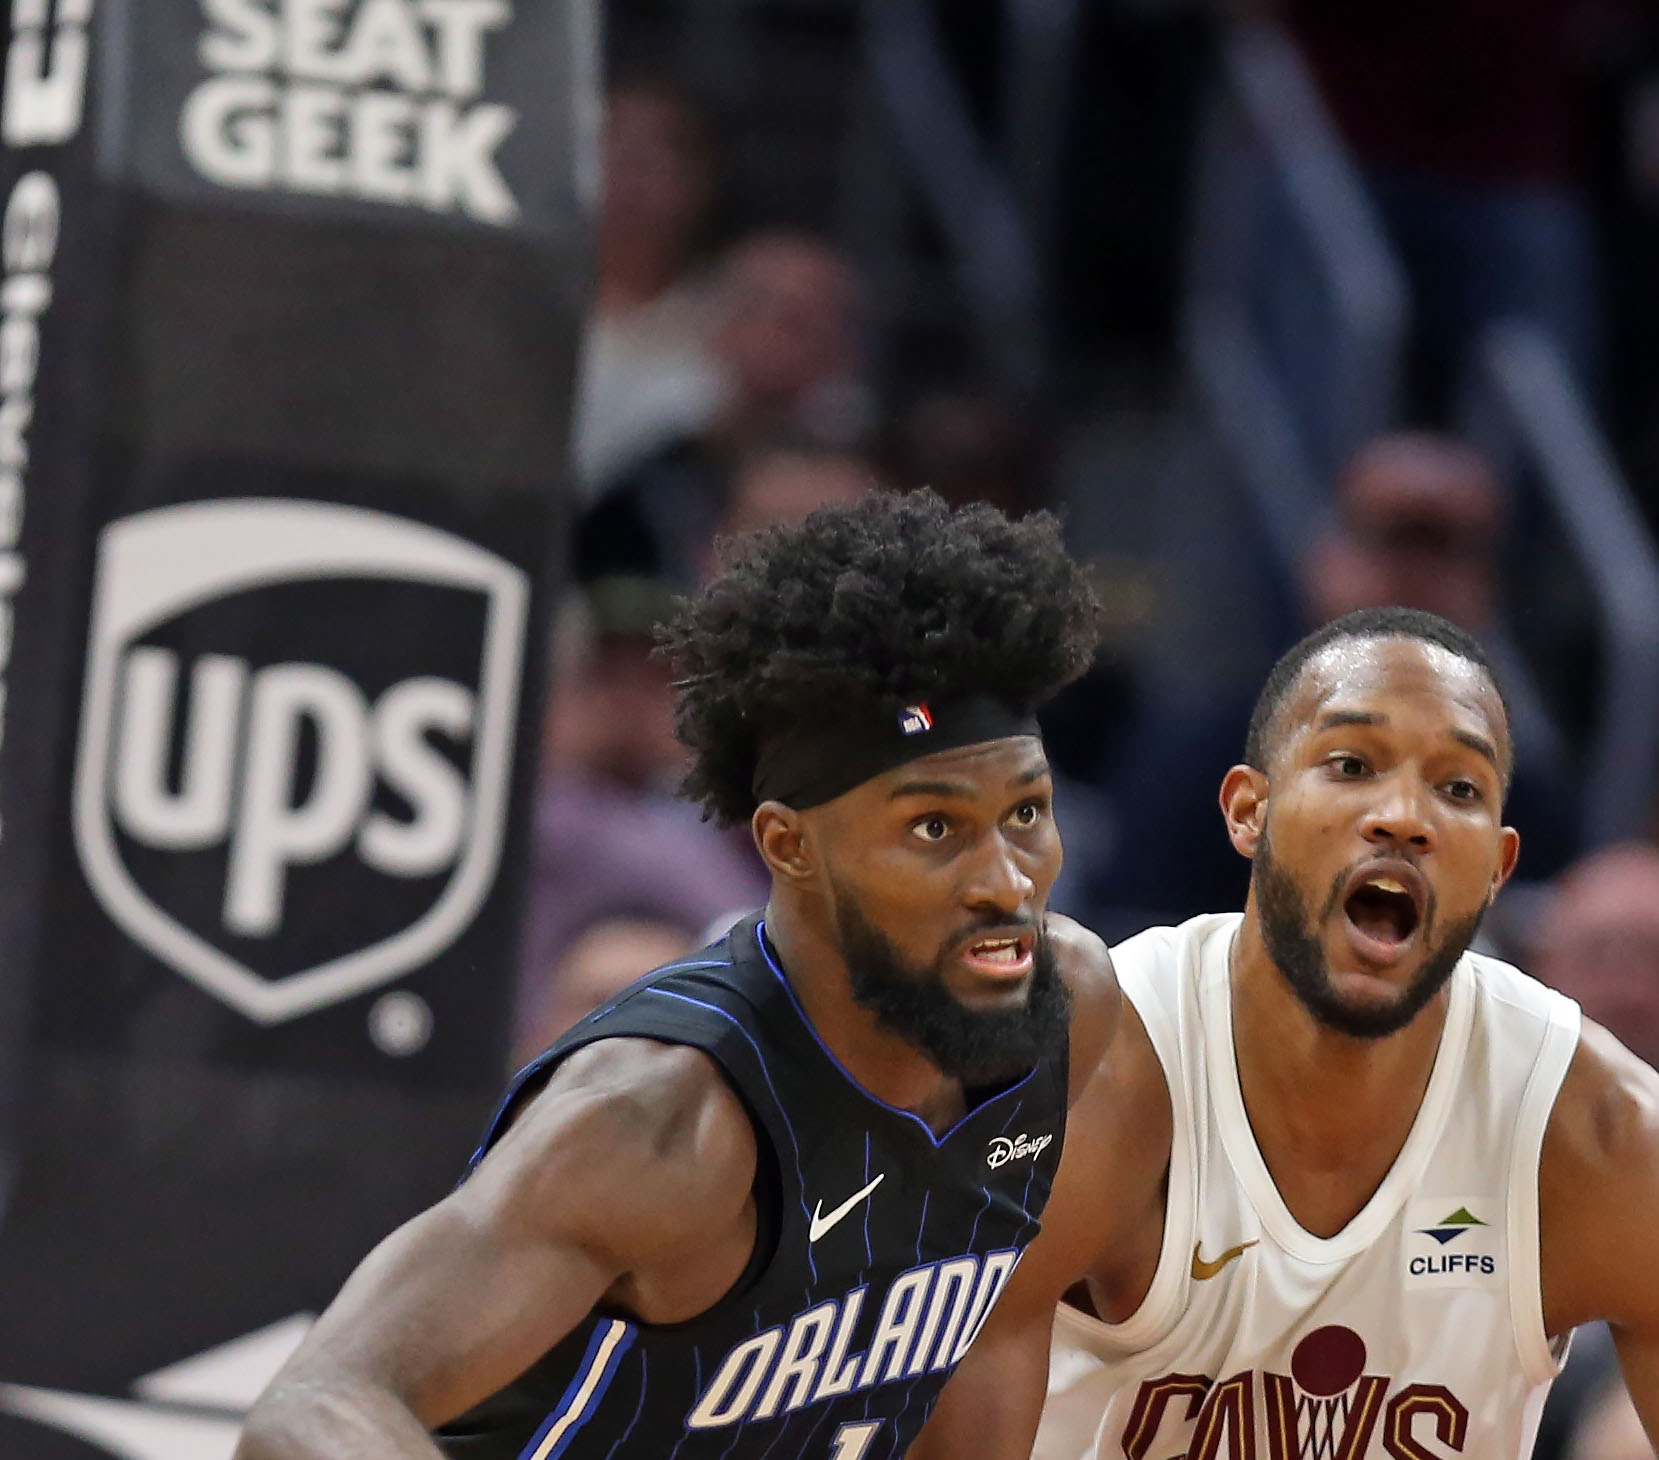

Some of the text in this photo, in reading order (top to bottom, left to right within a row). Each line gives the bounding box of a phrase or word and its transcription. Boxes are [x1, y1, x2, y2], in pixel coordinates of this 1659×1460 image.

[197, 0, 513, 97] SEAT
[178, 75, 521, 226] GEEK
[114, 642, 480, 938] ups
[986, 1133, 1052, 1171] Disney
[1409, 1254, 1496, 1276] CLIFFS
[686, 1246, 1024, 1431] ORLAND
